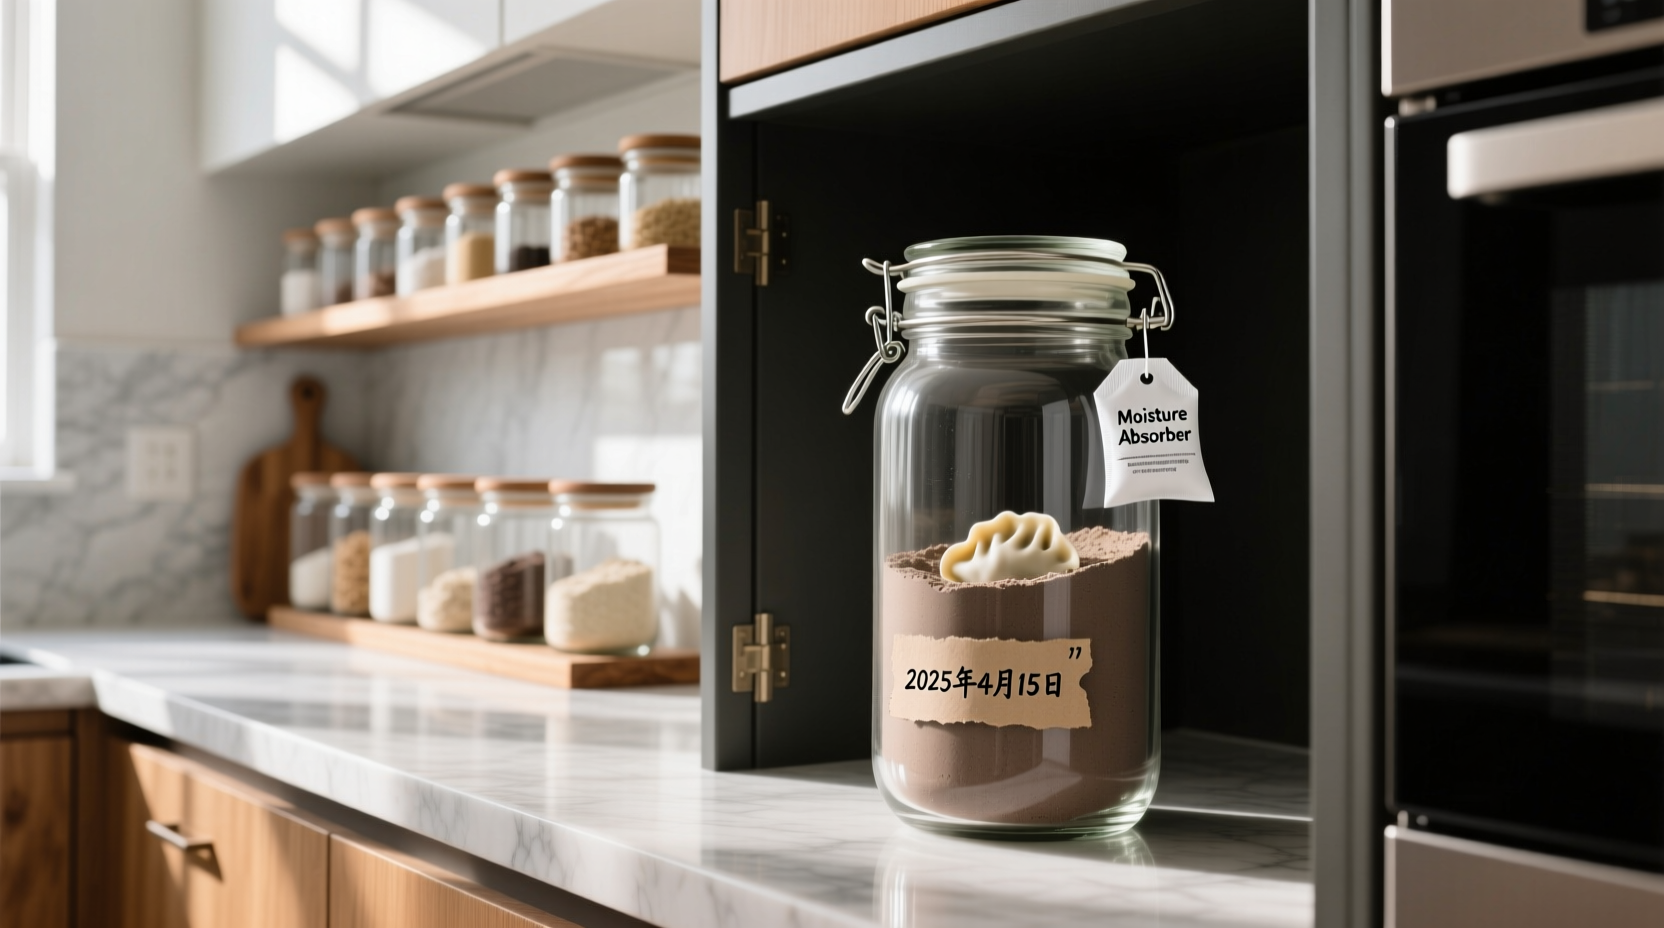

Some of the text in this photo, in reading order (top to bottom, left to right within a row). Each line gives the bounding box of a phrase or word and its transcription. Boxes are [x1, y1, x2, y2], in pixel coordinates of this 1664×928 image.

[1118, 408, 1187, 425] Moisture
[1118, 427, 1191, 445] Absorber
[905, 666, 1061, 699] 2025年4月15日
